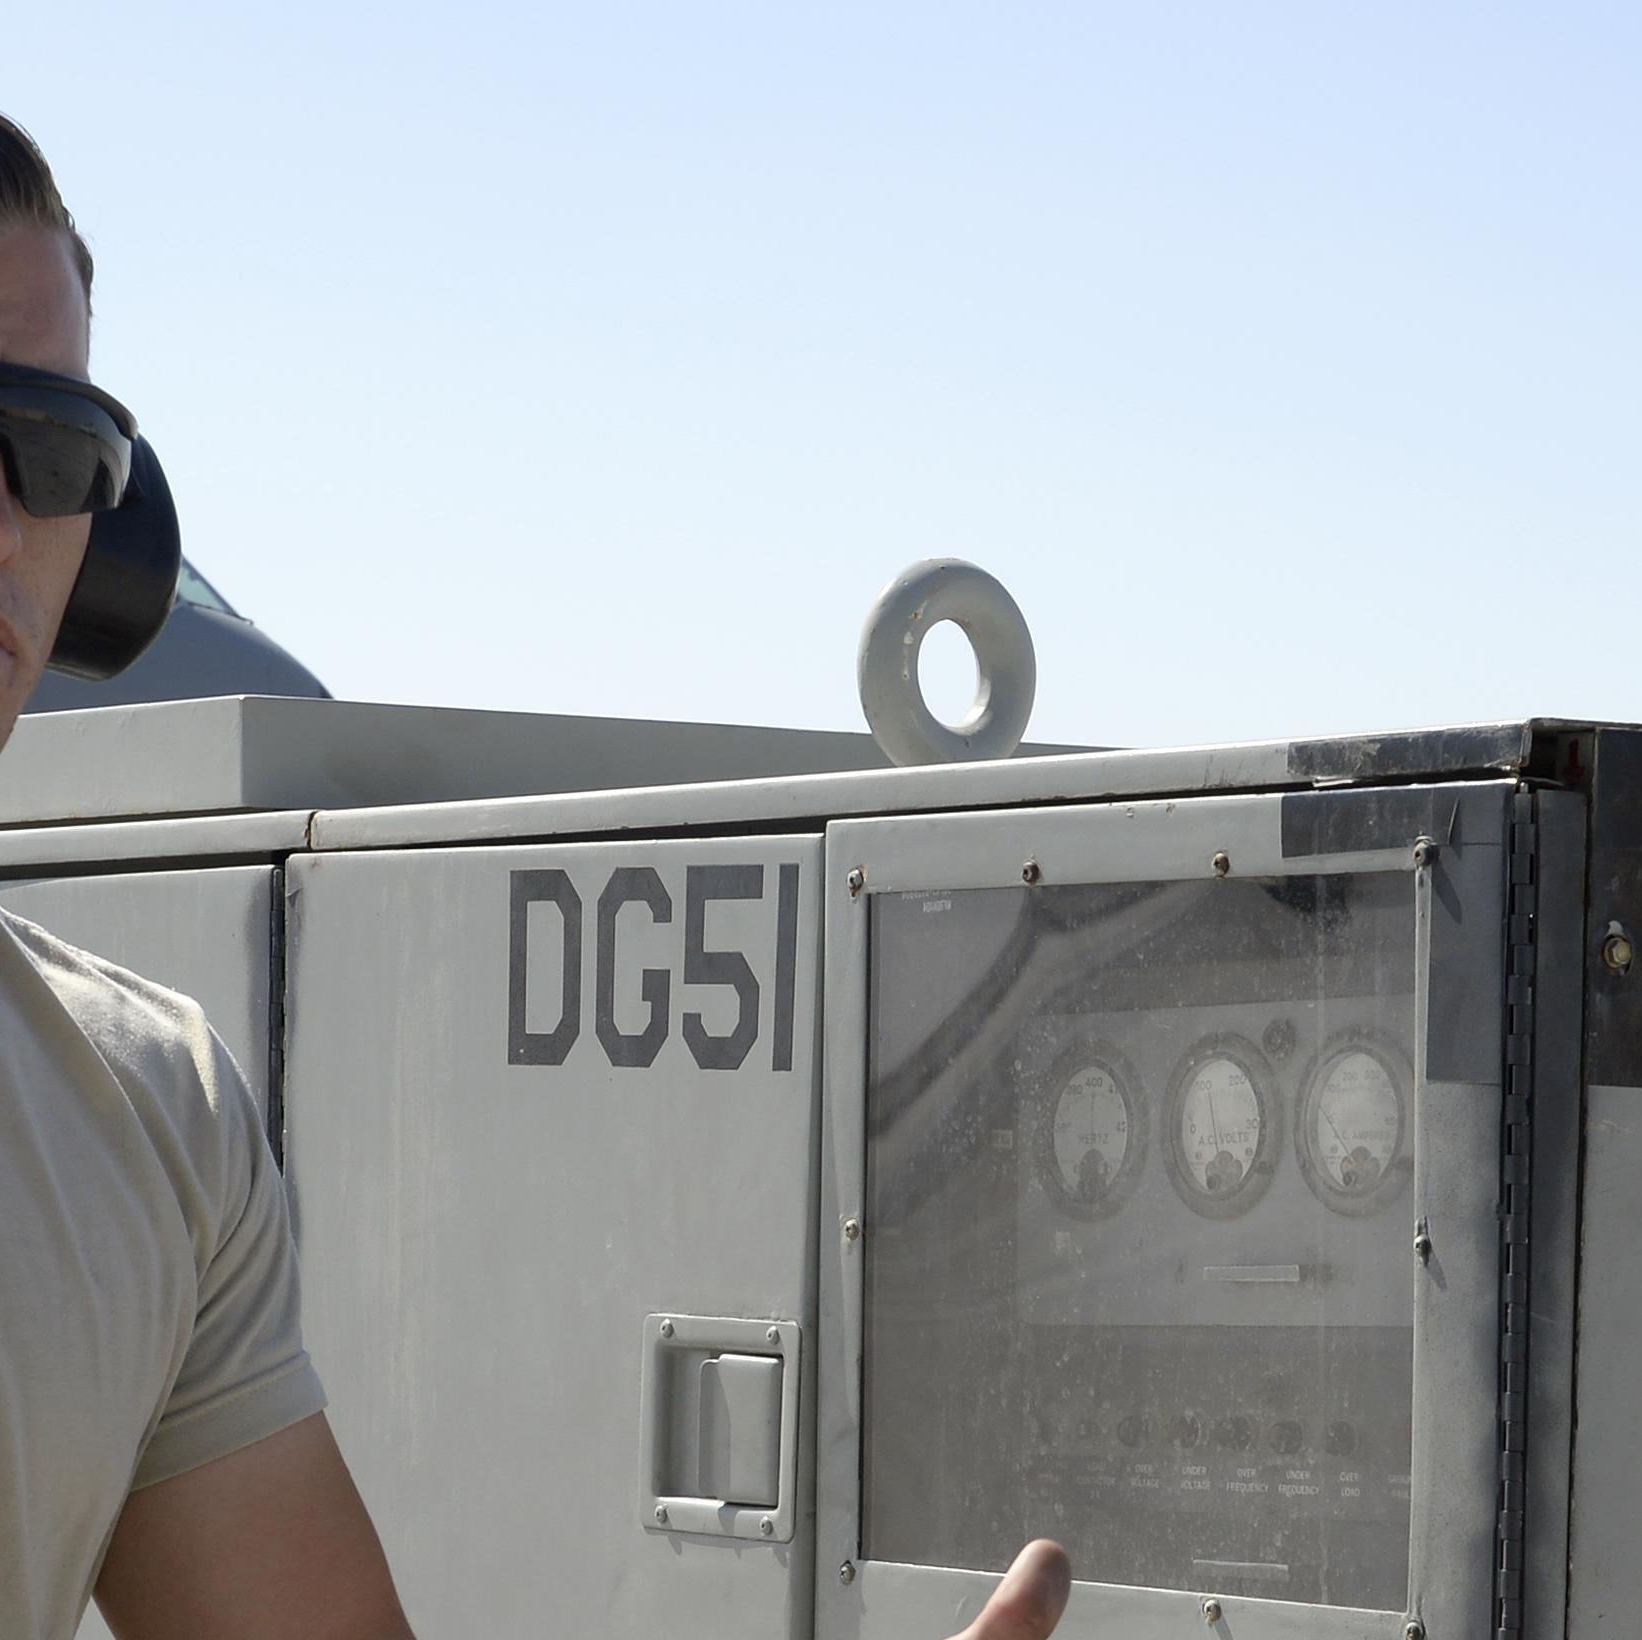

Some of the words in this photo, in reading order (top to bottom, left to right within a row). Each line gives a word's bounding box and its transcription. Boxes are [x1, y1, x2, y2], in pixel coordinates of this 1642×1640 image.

[507, 863, 800, 1071] DG51
[1219, 1131, 1249, 1144] VOLTS
[1181, 1464, 1207, 1475] UNDER
[1236, 1468, 1256, 1478] OVER
[1285, 1470, 1310, 1480] UNDER
[1180, 1479, 1211, 1490] VOLTAGE
[1226, 1481, 1269, 1494] FREQUENCY
[1278, 1483, 1319, 1495] FREQUENCY
[1340, 1487, 1360, 1497] LOAD
